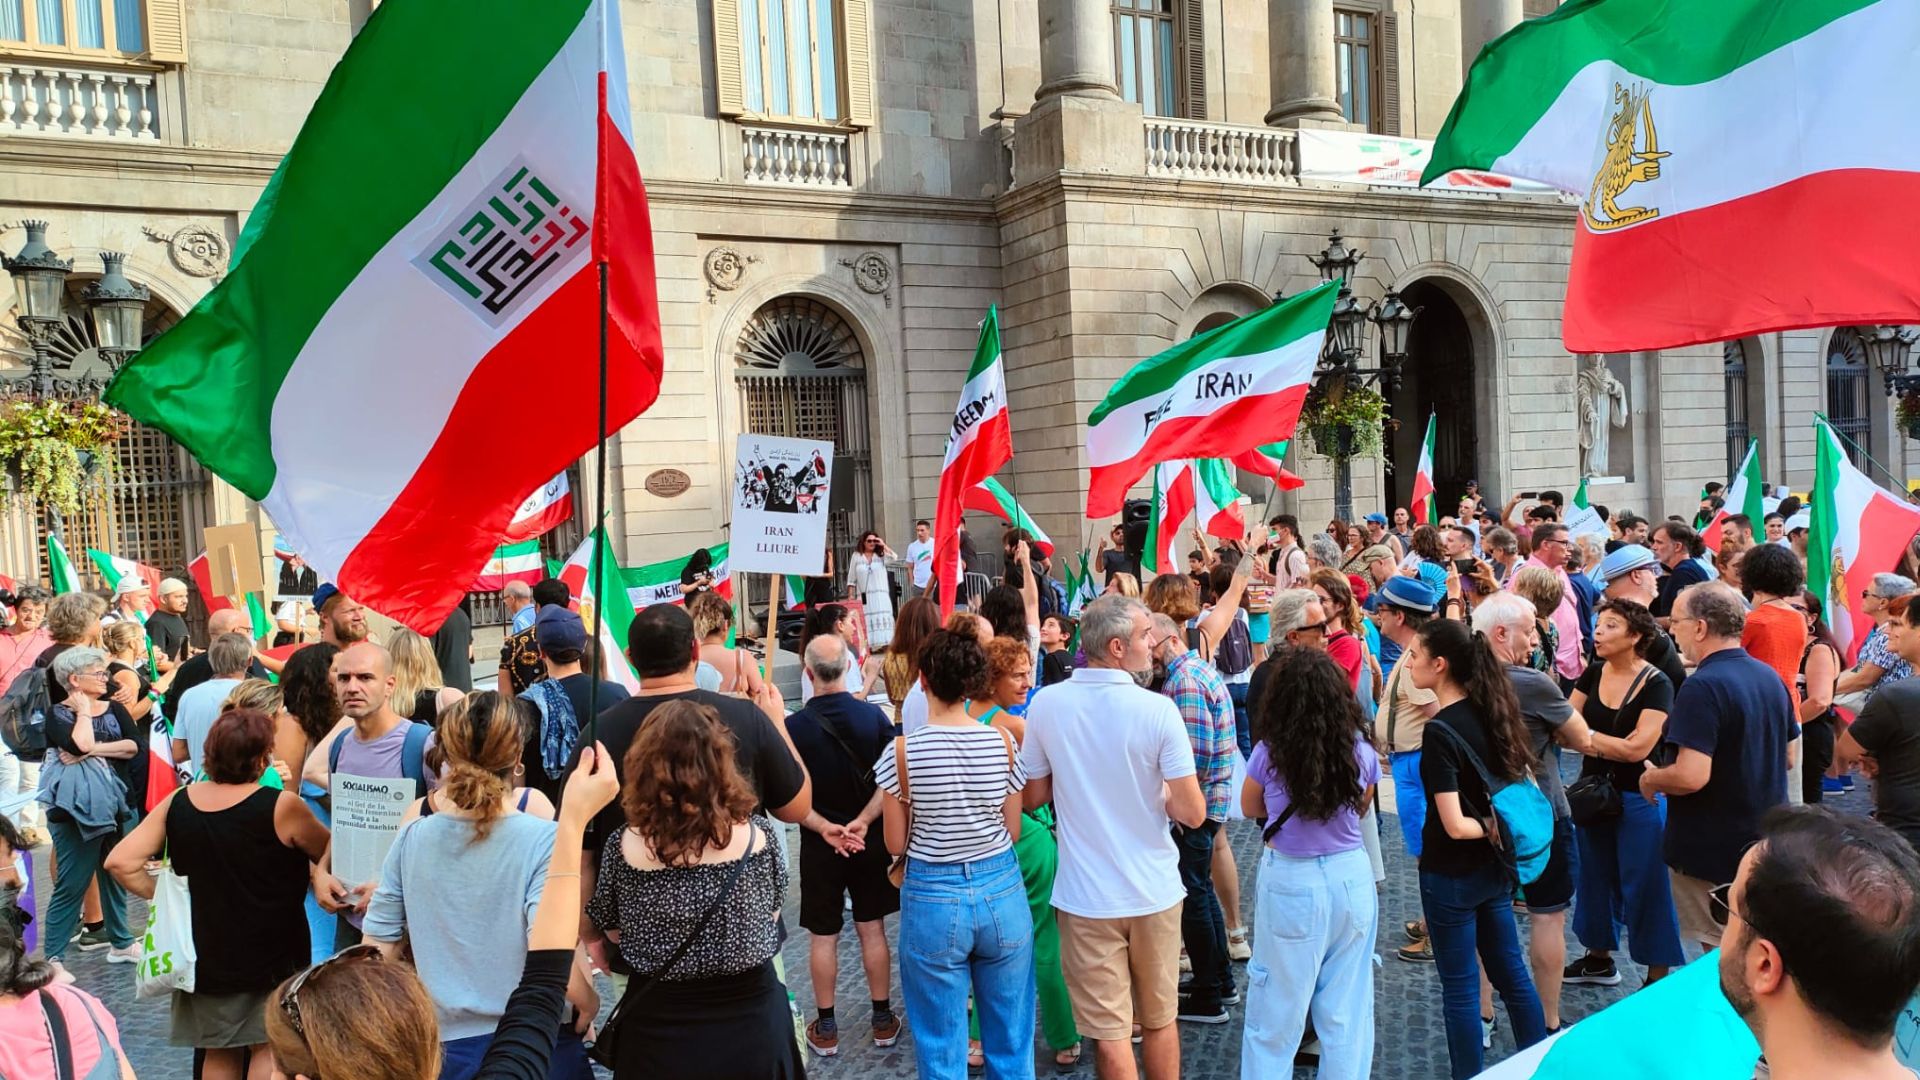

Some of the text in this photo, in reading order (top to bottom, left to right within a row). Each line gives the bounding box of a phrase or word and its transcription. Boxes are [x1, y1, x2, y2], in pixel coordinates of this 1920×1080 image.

[1144, 371, 1253, 437] FE IRAN
[764, 526, 794, 537] IRAN
[756, 543, 800, 554] LLIURE
[654, 583, 681, 601] MEH
[342, 781, 389, 794] SOCIALISMO
